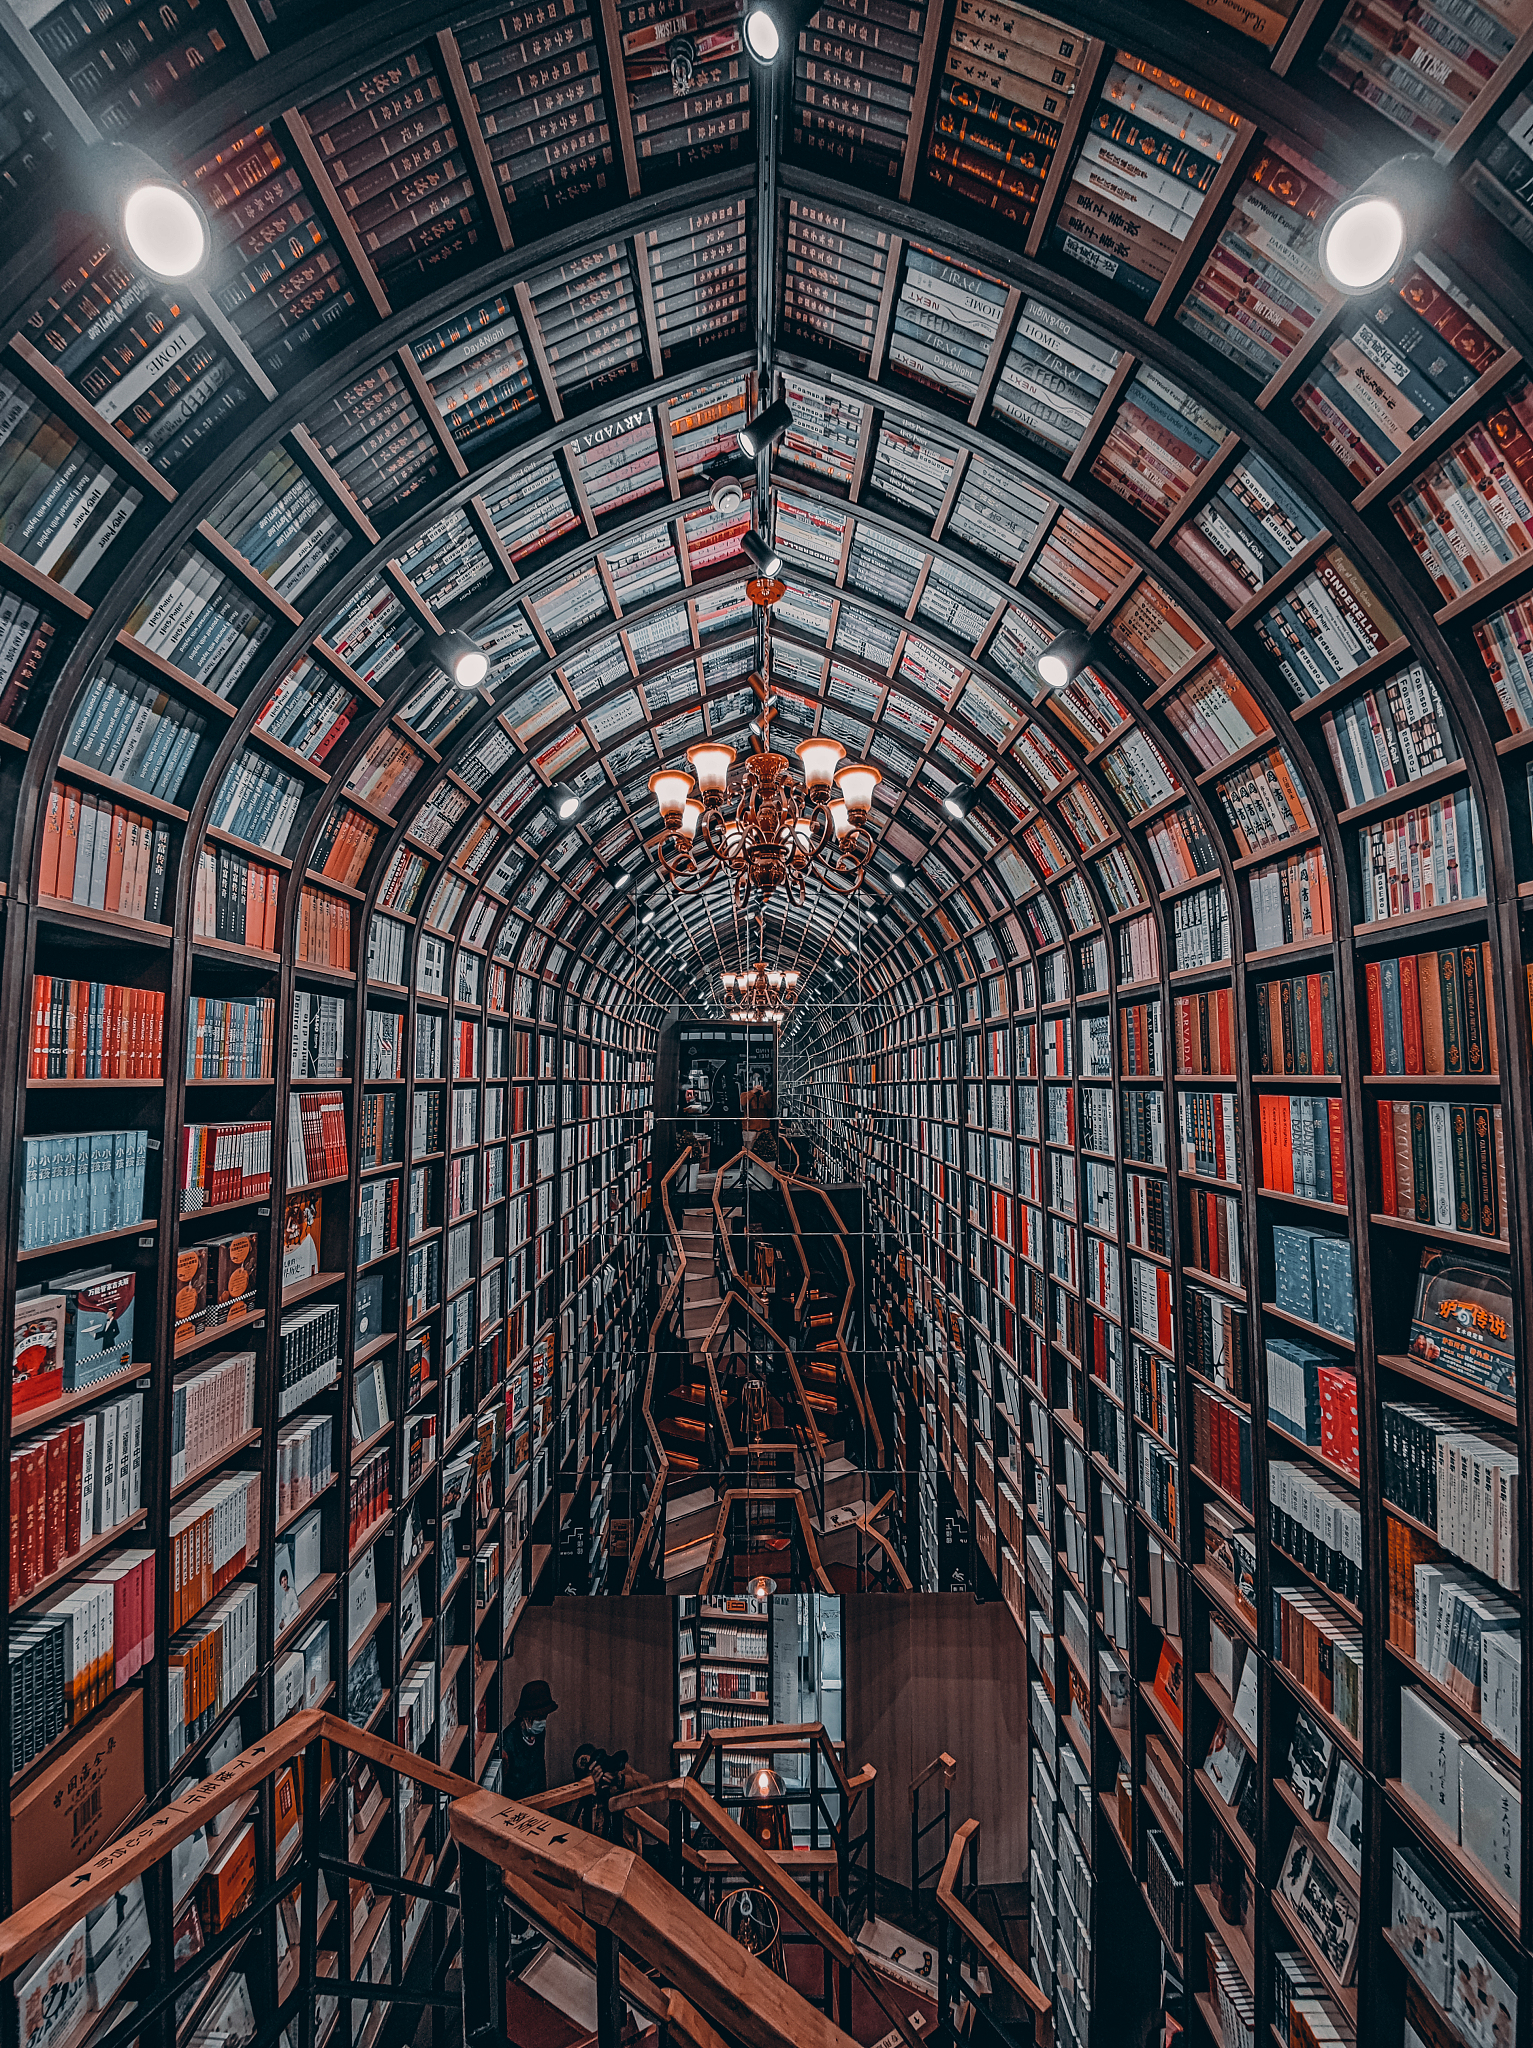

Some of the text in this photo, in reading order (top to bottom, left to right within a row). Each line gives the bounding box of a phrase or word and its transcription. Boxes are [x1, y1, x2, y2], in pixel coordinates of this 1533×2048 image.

[145, 334, 187, 376] HOME
[463, 328, 505, 356] Day&Night
[1025, 323, 1061, 351] HOME
[933, 354, 973, 378] Day&Night
[583, 411, 644, 447] ARVADA
[1006, 404, 1040, 429] HOME
[1324, 568, 1379, 642] CINDERELLA
[1143, 730, 1175, 785] CINDERELLA
[156, 832, 169, 876] 财富传奇
[1182, 1011, 1191, 1063] ARVADA
[1399, 1121, 1412, 1201] ARVADA
[1438, 1300, 1508, 1341] 炉石传说
[95, 1830, 153, 1869] 小心台阶
